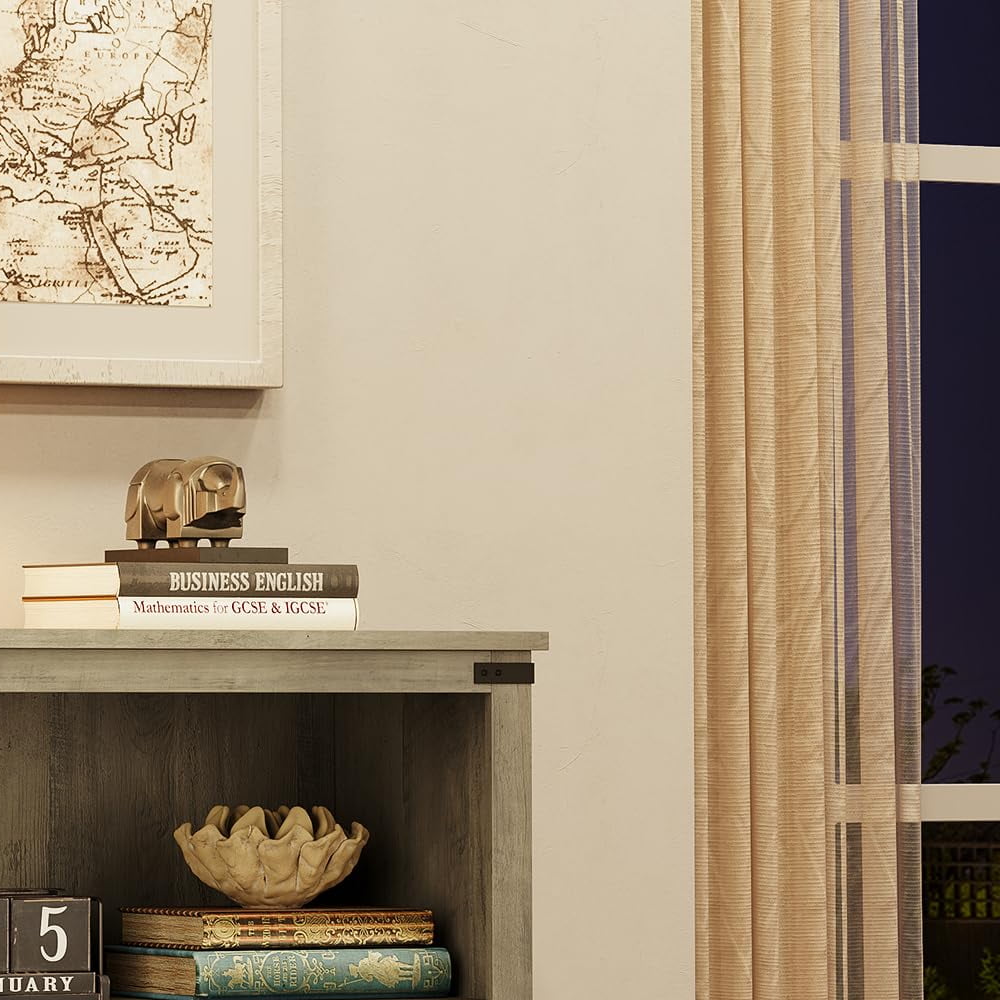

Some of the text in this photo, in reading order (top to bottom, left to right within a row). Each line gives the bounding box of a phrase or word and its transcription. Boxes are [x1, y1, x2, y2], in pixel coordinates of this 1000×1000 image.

[85, 52, 152, 60] EUROPE
[168, 571, 250, 592] BUSINESS
[254, 571, 324, 592] ENGLISH
[132, 600, 210, 615] Mathematics
[212, 600, 229, 615] for
[231, 600, 268, 615] GCSE
[270, 601, 282, 615] &
[39, 905, 68, 962] 5
[287, 955, 297, 987] RIDER
